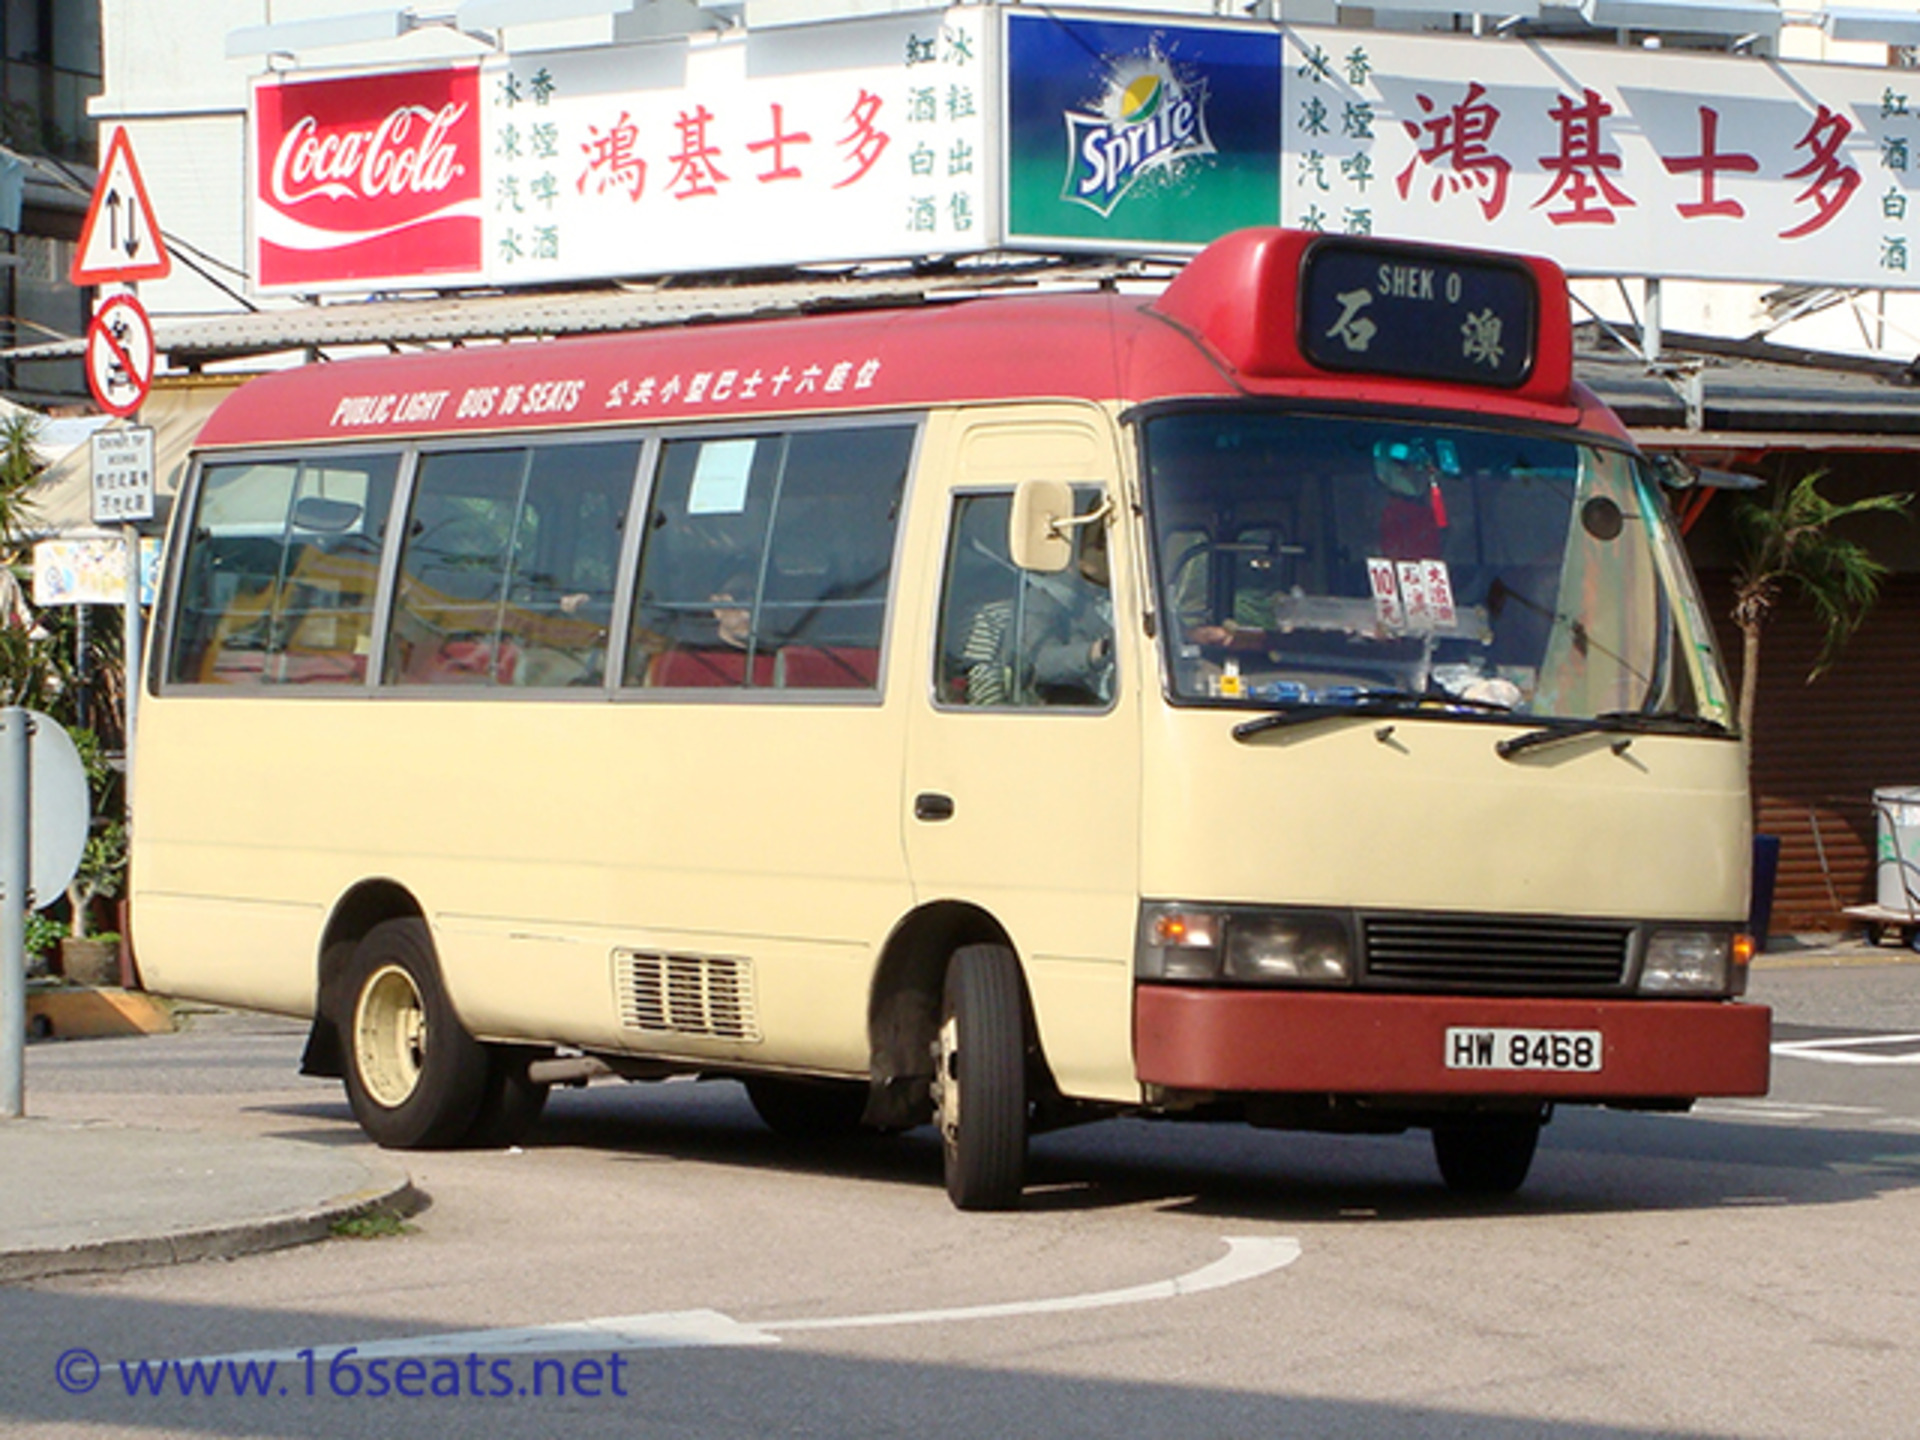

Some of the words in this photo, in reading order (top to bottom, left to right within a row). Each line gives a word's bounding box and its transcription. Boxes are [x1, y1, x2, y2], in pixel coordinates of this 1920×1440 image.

[272, 101, 468, 205] Coca-Cola
[495, 71, 524, 264] 冰凍汽水
[529, 67, 559, 261] 香煙啤酒
[575, 88, 891, 203] 鴻基士多
[904, 33, 937, 234] 紅酒白酒
[943, 26, 977, 234] 冰粒出售
[1079, 92, 1196, 197] Sprite
[1297, 45, 1330, 232] 冰凍汽水
[1341, 46, 1375, 236] 香煙啤酒
[1394, 81, 1863, 239] 鴻基士多
[1880, 86, 1910, 272] 紅酒白酒
[1325, 288, 1505, 369] 石澳
[1377, 264, 1435, 300] SHEK
[1446, 272, 1462, 304] O
[329, 394, 397, 427] PUBLIC
[391, 389, 450, 424] LIGHT
[455, 386, 500, 420] BUS
[497, 383, 525, 416] 16
[521, 380, 586, 414] SEATS
[1453, 1032, 1495, 1066] HW
[1508, 1034, 1594, 1068] 8468
